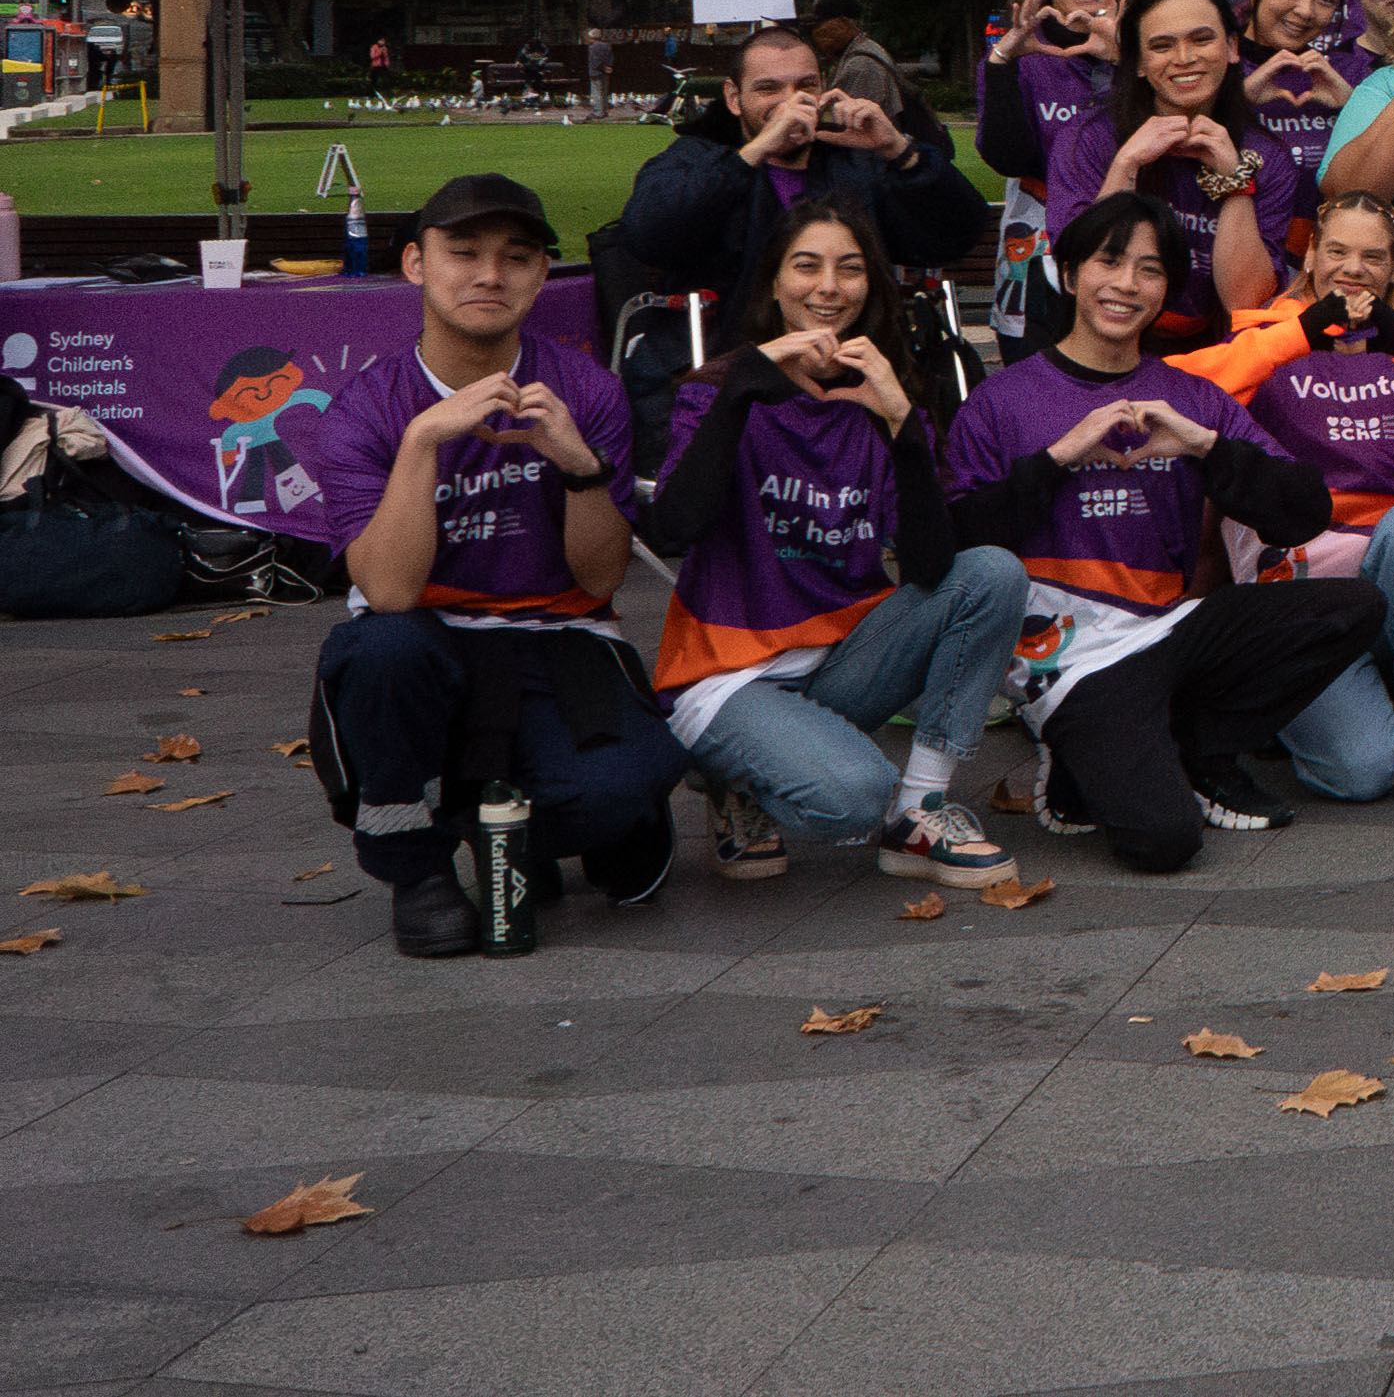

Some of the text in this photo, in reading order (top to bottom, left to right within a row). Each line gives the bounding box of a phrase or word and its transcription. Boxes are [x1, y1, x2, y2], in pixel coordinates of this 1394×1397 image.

[49, 331, 114, 352] Sydney
[48, 355, 134, 373] Children's
[49, 379, 127, 399] Hospitals
[1329, 427, 1382, 441] SCHF
[434, 461, 548, 503] oluntee
[758, 474, 871, 509] All in for
[1081, 502, 1129, 518] SCHF
[447, 525, 497, 544] SCHF
[491, 833, 511, 942] Kathmandu
